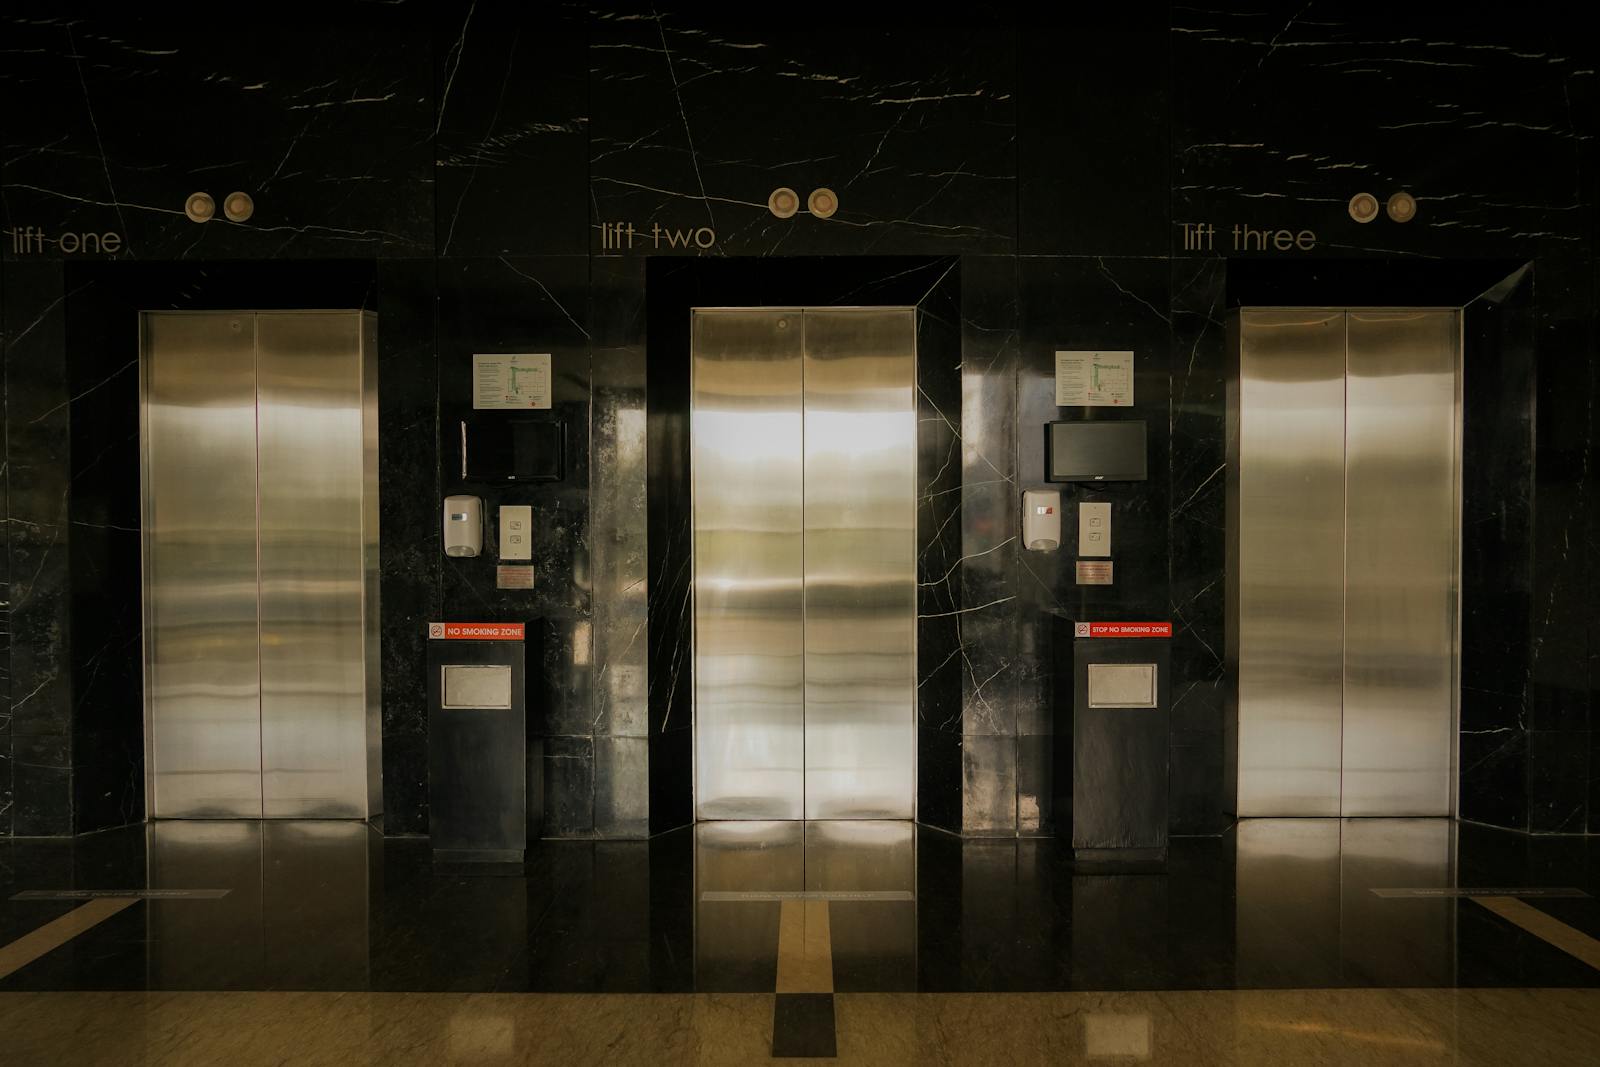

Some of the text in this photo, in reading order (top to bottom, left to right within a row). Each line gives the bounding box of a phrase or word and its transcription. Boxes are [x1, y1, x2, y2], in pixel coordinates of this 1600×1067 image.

[12, 227, 122, 254] lift one
[602, 222, 716, 249] lift two
[1184, 223, 1317, 250] lift three
[447, 628, 522, 636] NO SMOKING ZONE
